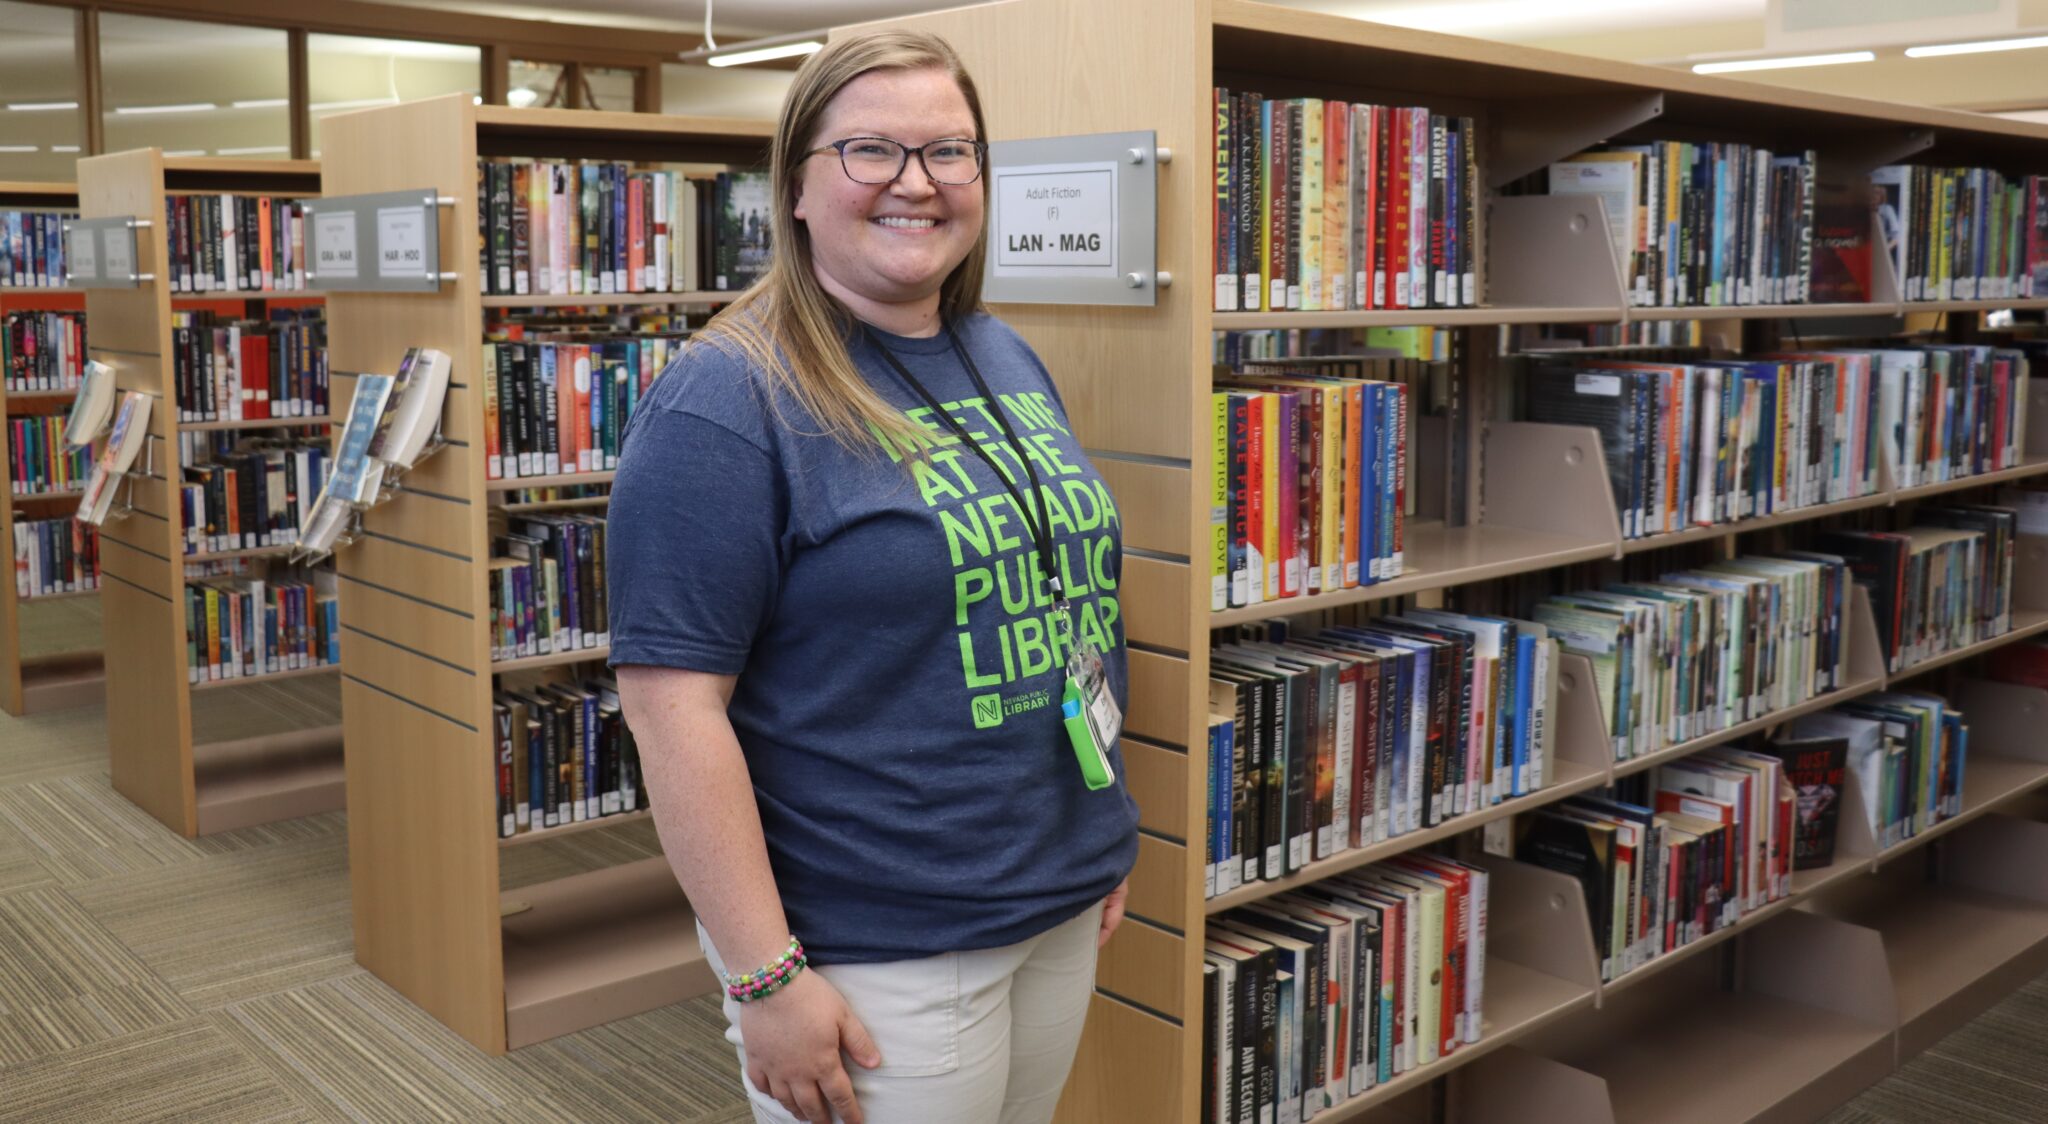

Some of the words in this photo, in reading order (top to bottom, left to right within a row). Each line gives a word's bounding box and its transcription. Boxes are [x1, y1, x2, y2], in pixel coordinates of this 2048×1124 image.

[1216, 100, 1229, 203] TALENT
[1253, 127, 1261, 211] UNSPOKEN
[1433, 127, 1441, 178] LASHNER
[1026, 188, 1049, 200] Adult
[1052, 186, 1081, 199] Fiction
[1047, 206, 1059, 220] (F)
[1242, 158, 1250, 232] LARKWOOD
[1253, 215, 1261, 259] NAME
[1799, 150, 1816, 281] CALIFORN
[384, 250, 398, 261] HAR
[1009, 234, 1044, 252] LAN
[1060, 233, 1101, 252] MAG
[487, 370, 495, 392] LOST
[502, 351, 511, 373] JANE
[488, 396, 496, 416] MAN
[503, 376, 513, 411] HARPER
[546, 386, 556, 421] HARPER
[863, 397, 1006, 464] MEET
[1236, 407, 1246, 463] GALE
[1388, 395, 1398, 450] STEPHANIE
[911, 450, 978, 506] AT
[980, 433, 1082, 485] THE
[1387, 452, 1396, 494] LAURENS
[1397, 450, 1405, 490] LAURENS
[938, 479, 1121, 567] NEVADA
[1236, 475, 1247, 548] FORCE
[1217, 527, 1225, 575] COVE
[955, 535, 1117, 625] PUBLIC
[958, 597, 1126, 688] LIBRAR
[1005, 695, 1050, 716] LIBRARY
[1254, 686, 1262, 718] STEPHEN
[1275, 683, 1284, 715] STEPHEN
[1328, 706, 1334, 719] WE
[1343, 685, 1353, 717] RED
[1368, 679, 1377, 717] GREY
[1386, 675, 1396, 713] HOLY
[1415, 674, 1425, 732] MOUNTAIN
[1460, 684, 1472, 742] GIRLS
[1274, 726, 1283, 761] LAWHEAD
[1341, 720, 1352, 769] SISTER
[1367, 722, 1376, 766] SISTER
[1384, 719, 1394, 762] SISTER
[1233, 745, 1245, 813] WOMEN
[1363, 770, 1371, 815] LAWREN
[1458, 896, 1468, 942] RUNNER
[1262, 985, 1270, 1029] TOWER
[1241, 1046, 1255, 1074] ANN
[1240, 1077, 1254, 1121] LECKIE
[1260, 1065, 1269, 1104] LECKIE
